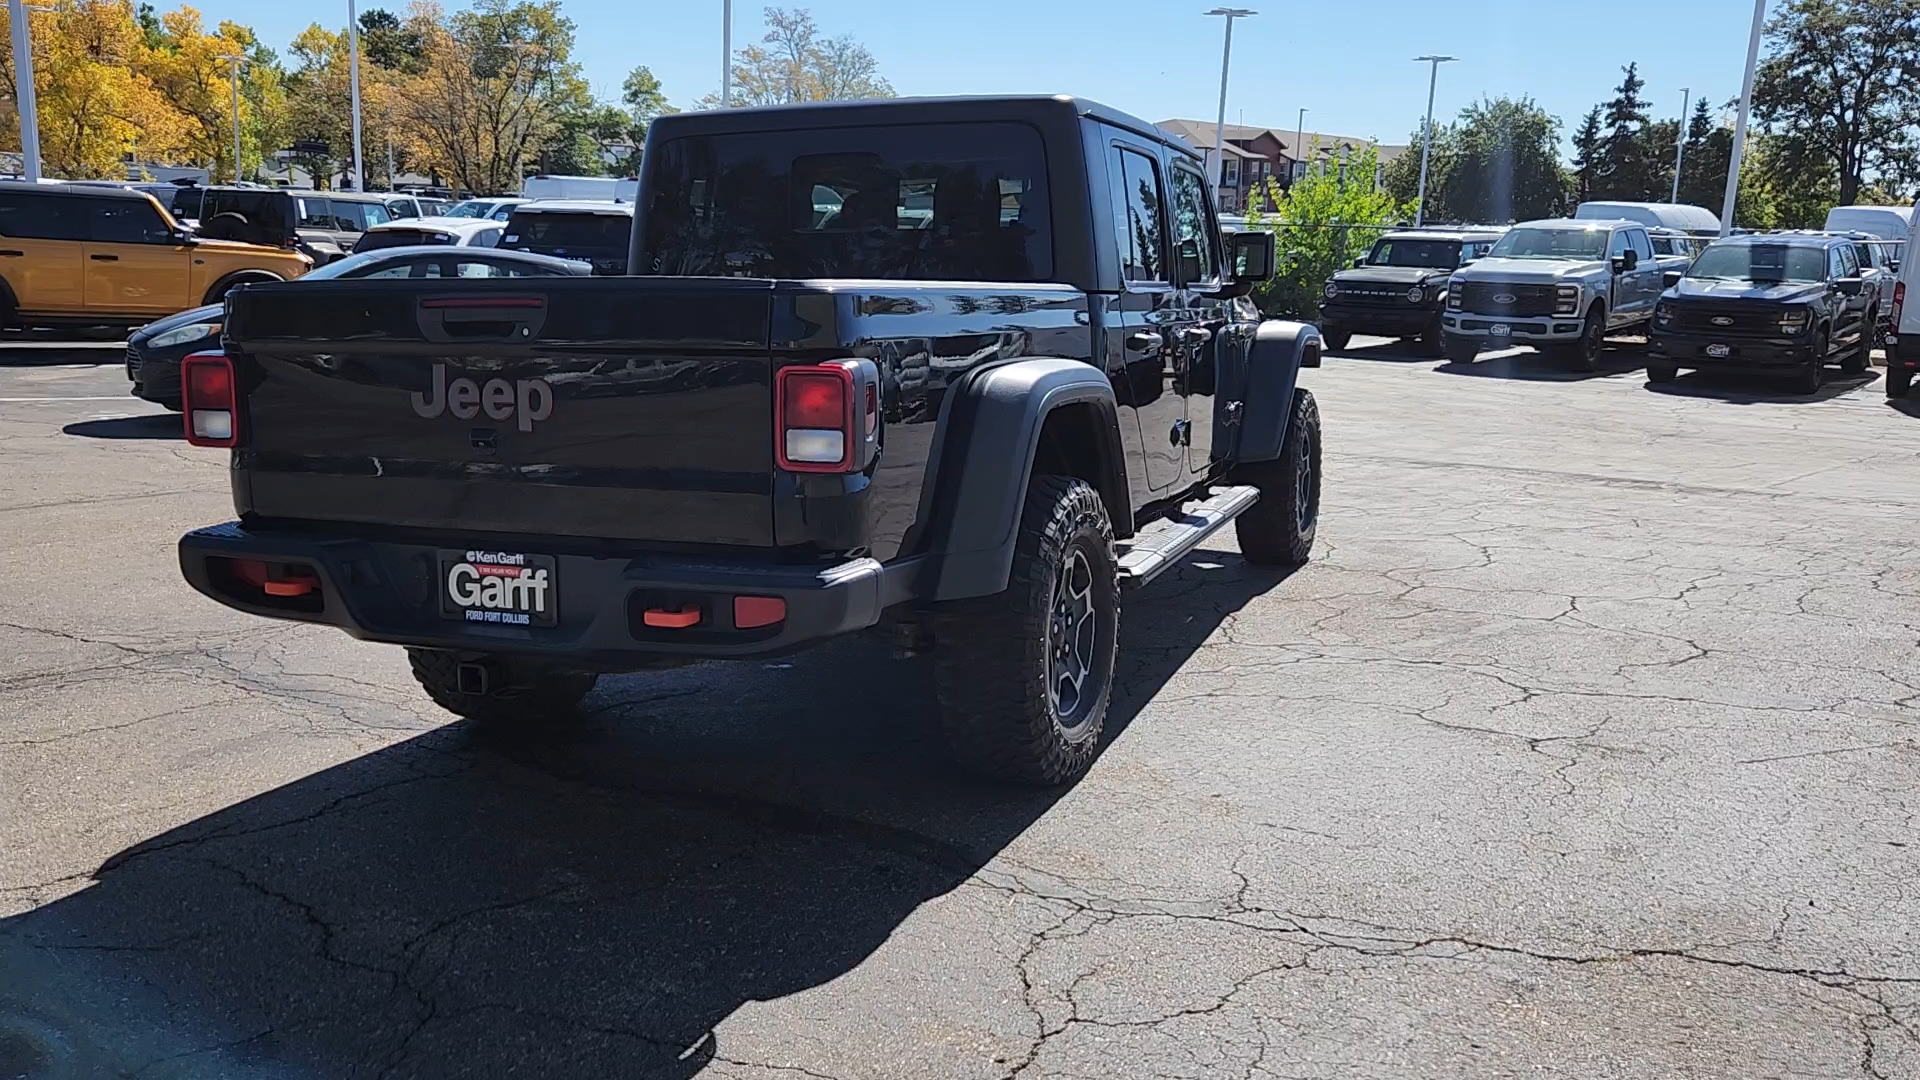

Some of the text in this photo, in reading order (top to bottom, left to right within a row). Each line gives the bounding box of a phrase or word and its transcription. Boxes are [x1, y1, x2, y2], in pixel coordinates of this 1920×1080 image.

[410, 363, 553, 432] Jeep
[475, 550, 524, 565] Ken Garff
[448, 563, 548, 612] Garff
[466, 610, 530, 625] FORD FORT COLLINS
